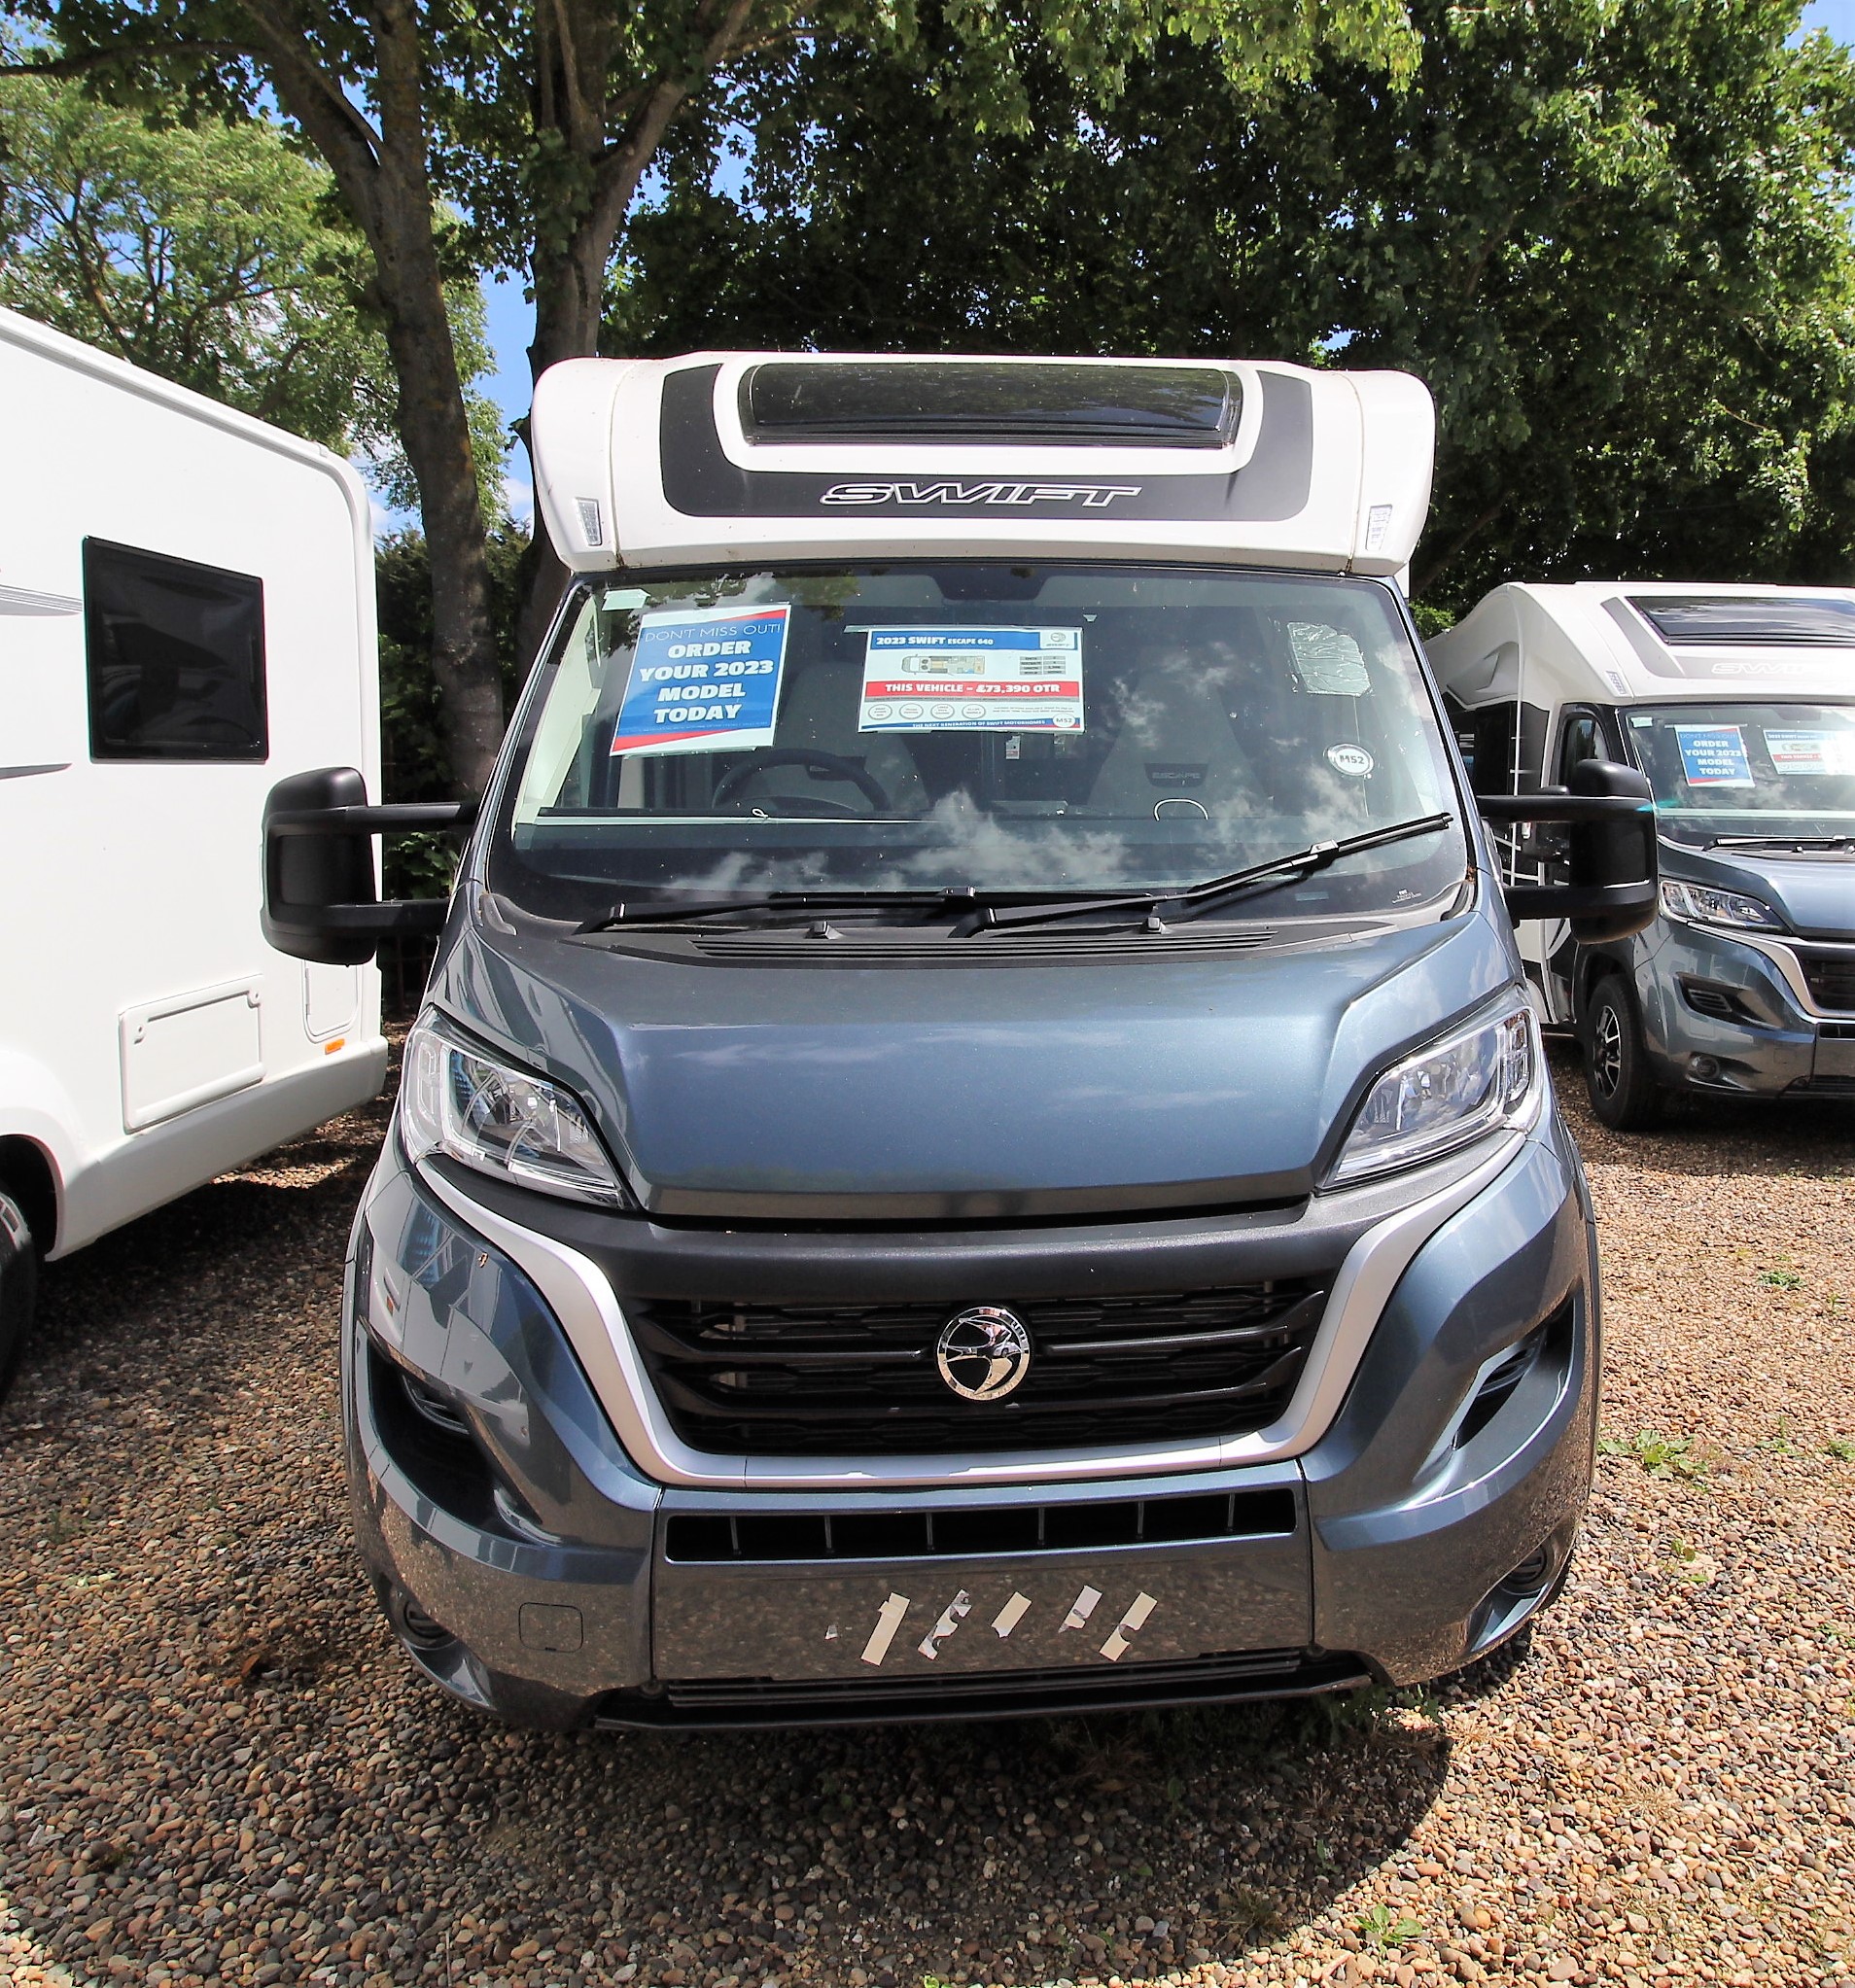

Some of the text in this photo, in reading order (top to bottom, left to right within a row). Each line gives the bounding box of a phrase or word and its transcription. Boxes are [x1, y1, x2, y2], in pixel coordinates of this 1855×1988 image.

[820, 482, 1141, 507] SWIFT
[646, 622, 781, 643] DON'T MISS OUT!
[876, 637, 906, 645] 2023
[908, 636, 946, 645] SWIFT
[668, 640, 752, 658] ORDER
[639, 659, 774, 681] YOUR 2023
[657, 682, 746, 701] MODEL
[885, 683, 913, 692] THIS
[916, 683, 964, 693] VEHICLE
[975, 684, 1031, 694] £73,390
[1032, 683, 1061, 693] OTR
[653, 704, 742, 723] TODAY
